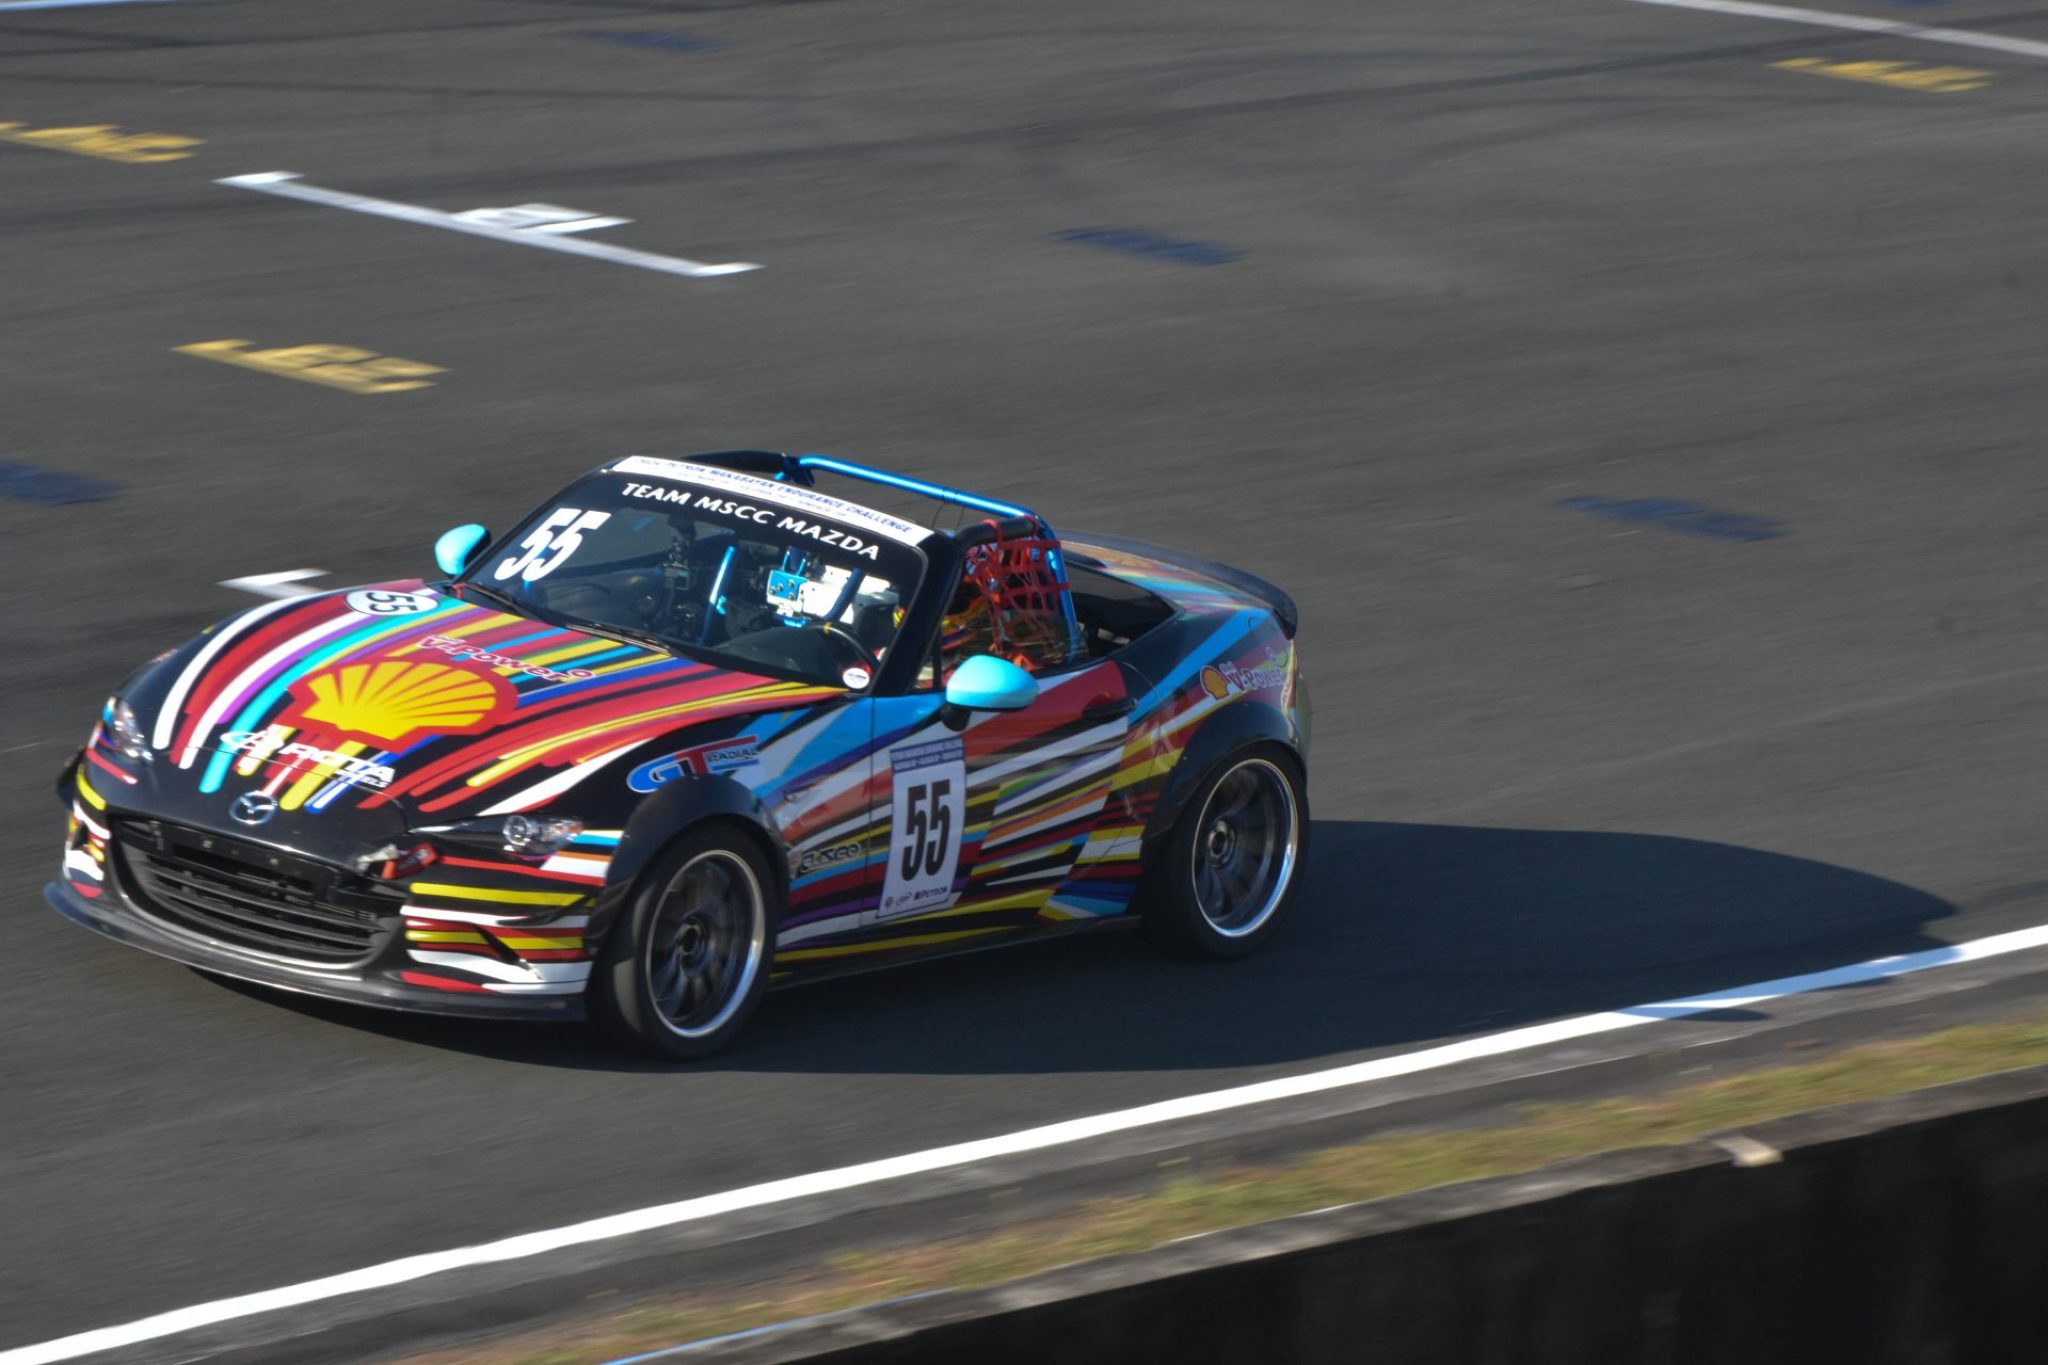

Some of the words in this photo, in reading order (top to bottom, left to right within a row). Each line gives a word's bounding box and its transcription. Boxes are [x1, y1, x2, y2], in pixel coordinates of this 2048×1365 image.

[494, 507, 612, 582] 55
[621, 482, 692, 506] TEAM
[693, 495, 776, 525] MSCC
[776, 515, 880, 561] MAZDA
[846, 501, 913, 534] CHALLENGE
[365, 591, 419, 613] 55
[277, 742, 396, 784] ROTA
[901, 778, 951, 882] 55
